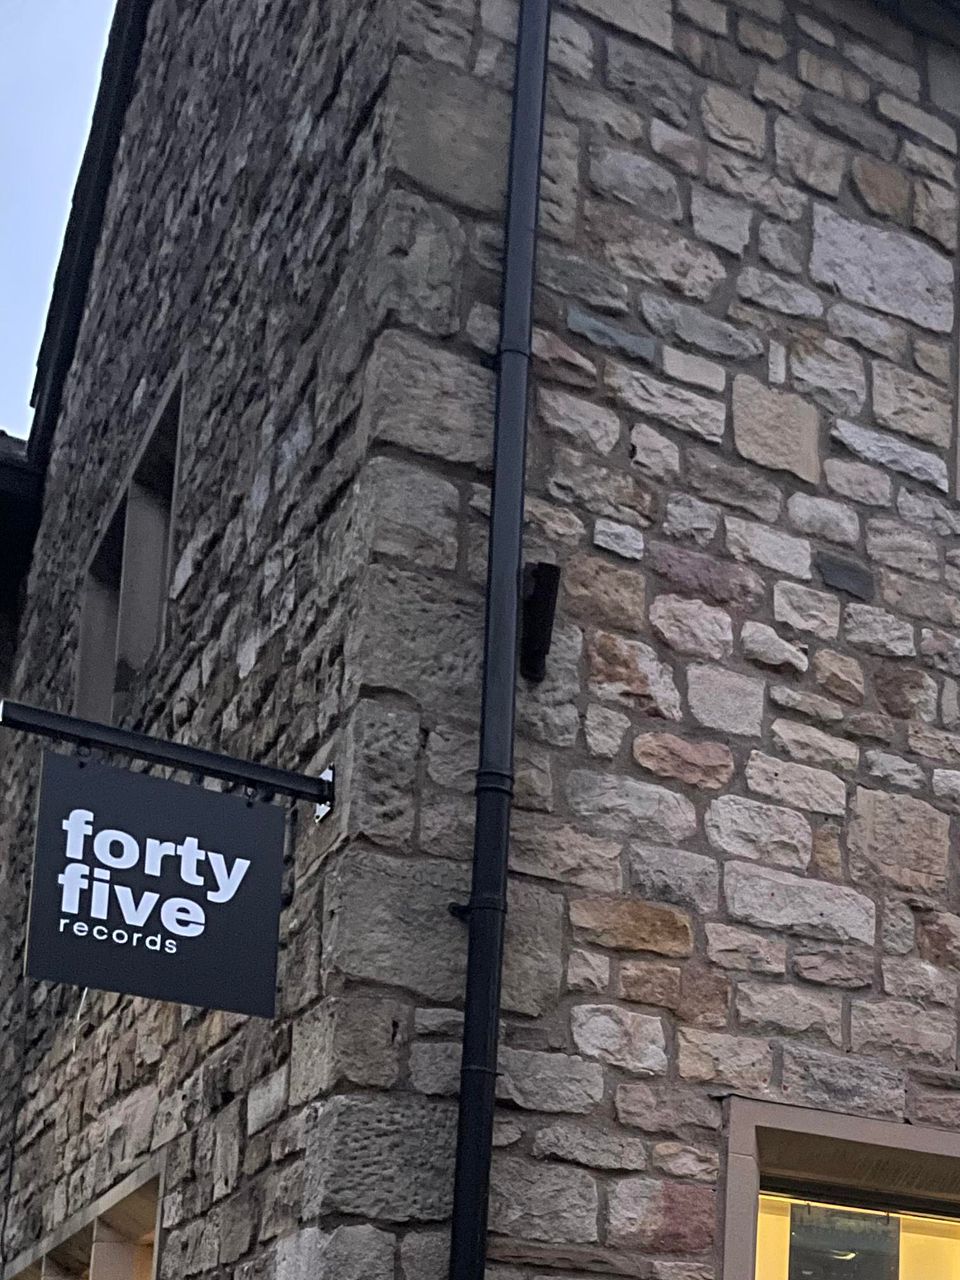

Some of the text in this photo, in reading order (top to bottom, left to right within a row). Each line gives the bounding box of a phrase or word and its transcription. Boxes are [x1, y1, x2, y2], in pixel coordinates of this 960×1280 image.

[62, 809, 250, 903] forty
[58, 863, 205, 937] five
[59, 918, 177, 953] records
